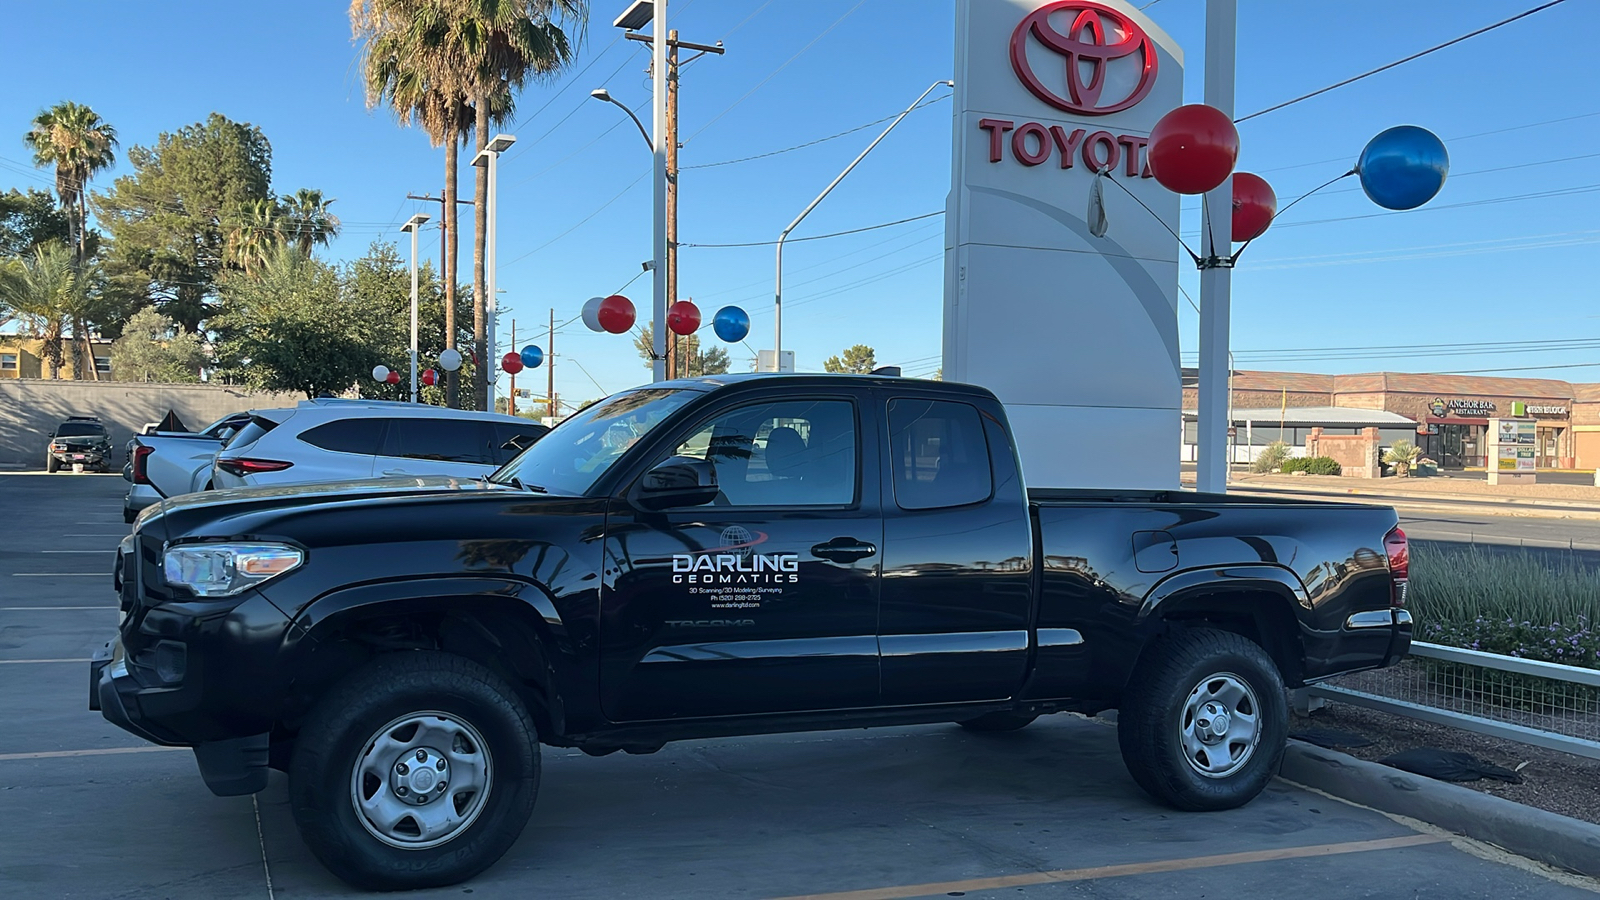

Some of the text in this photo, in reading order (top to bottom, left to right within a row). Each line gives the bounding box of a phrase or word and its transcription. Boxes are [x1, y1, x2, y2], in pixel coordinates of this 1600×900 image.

[1448, 399, 1494, 409] ANCHOR BAR
[1455, 408, 1488, 416] RESTAURANT
[672, 554, 798, 572] DARLING
[672, 574, 798, 583] GEOMATICS
[699, 587, 733, 595] Scanning/3D
[734, 587, 783, 595] Modeling/Surveying
[664, 619, 756, 628] TACOMA
